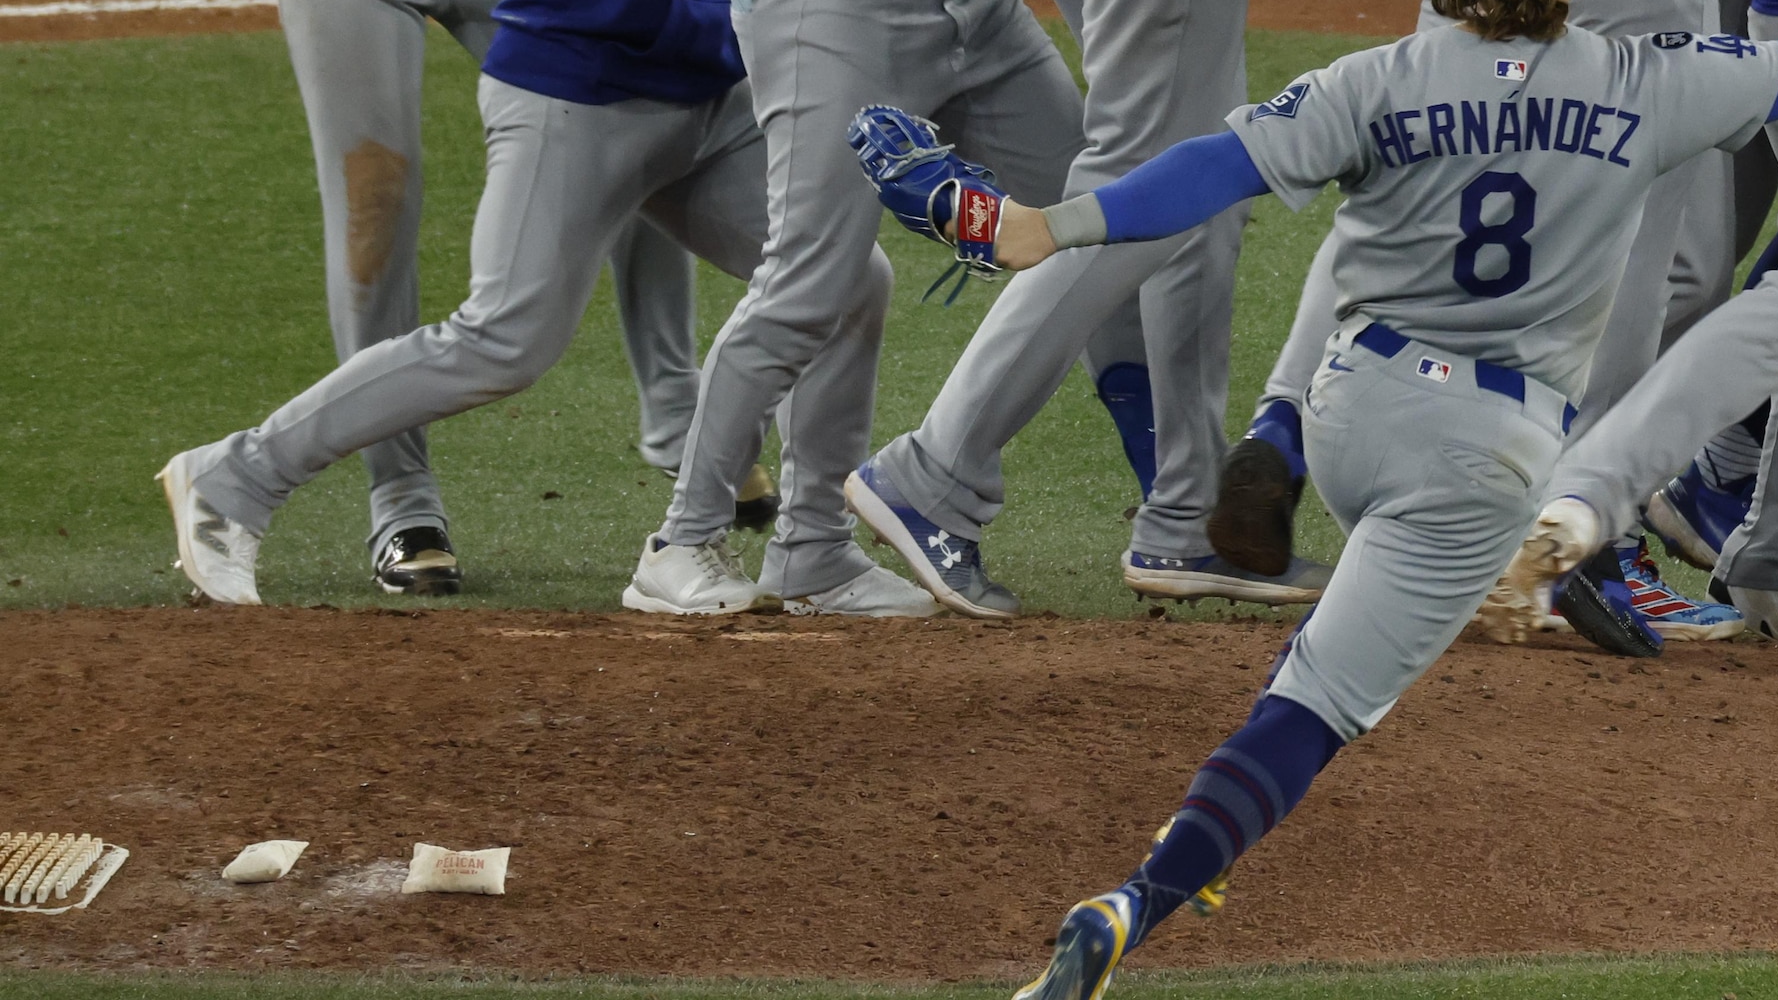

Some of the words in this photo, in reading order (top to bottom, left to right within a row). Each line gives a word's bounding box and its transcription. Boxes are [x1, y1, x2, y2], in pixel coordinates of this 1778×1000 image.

[1270, 90, 1297, 107] G
[1369, 89, 1641, 168] HERNÁNDEZ
[1452, 170, 1537, 298] 8
[436, 857, 485, 870] PELICAN
